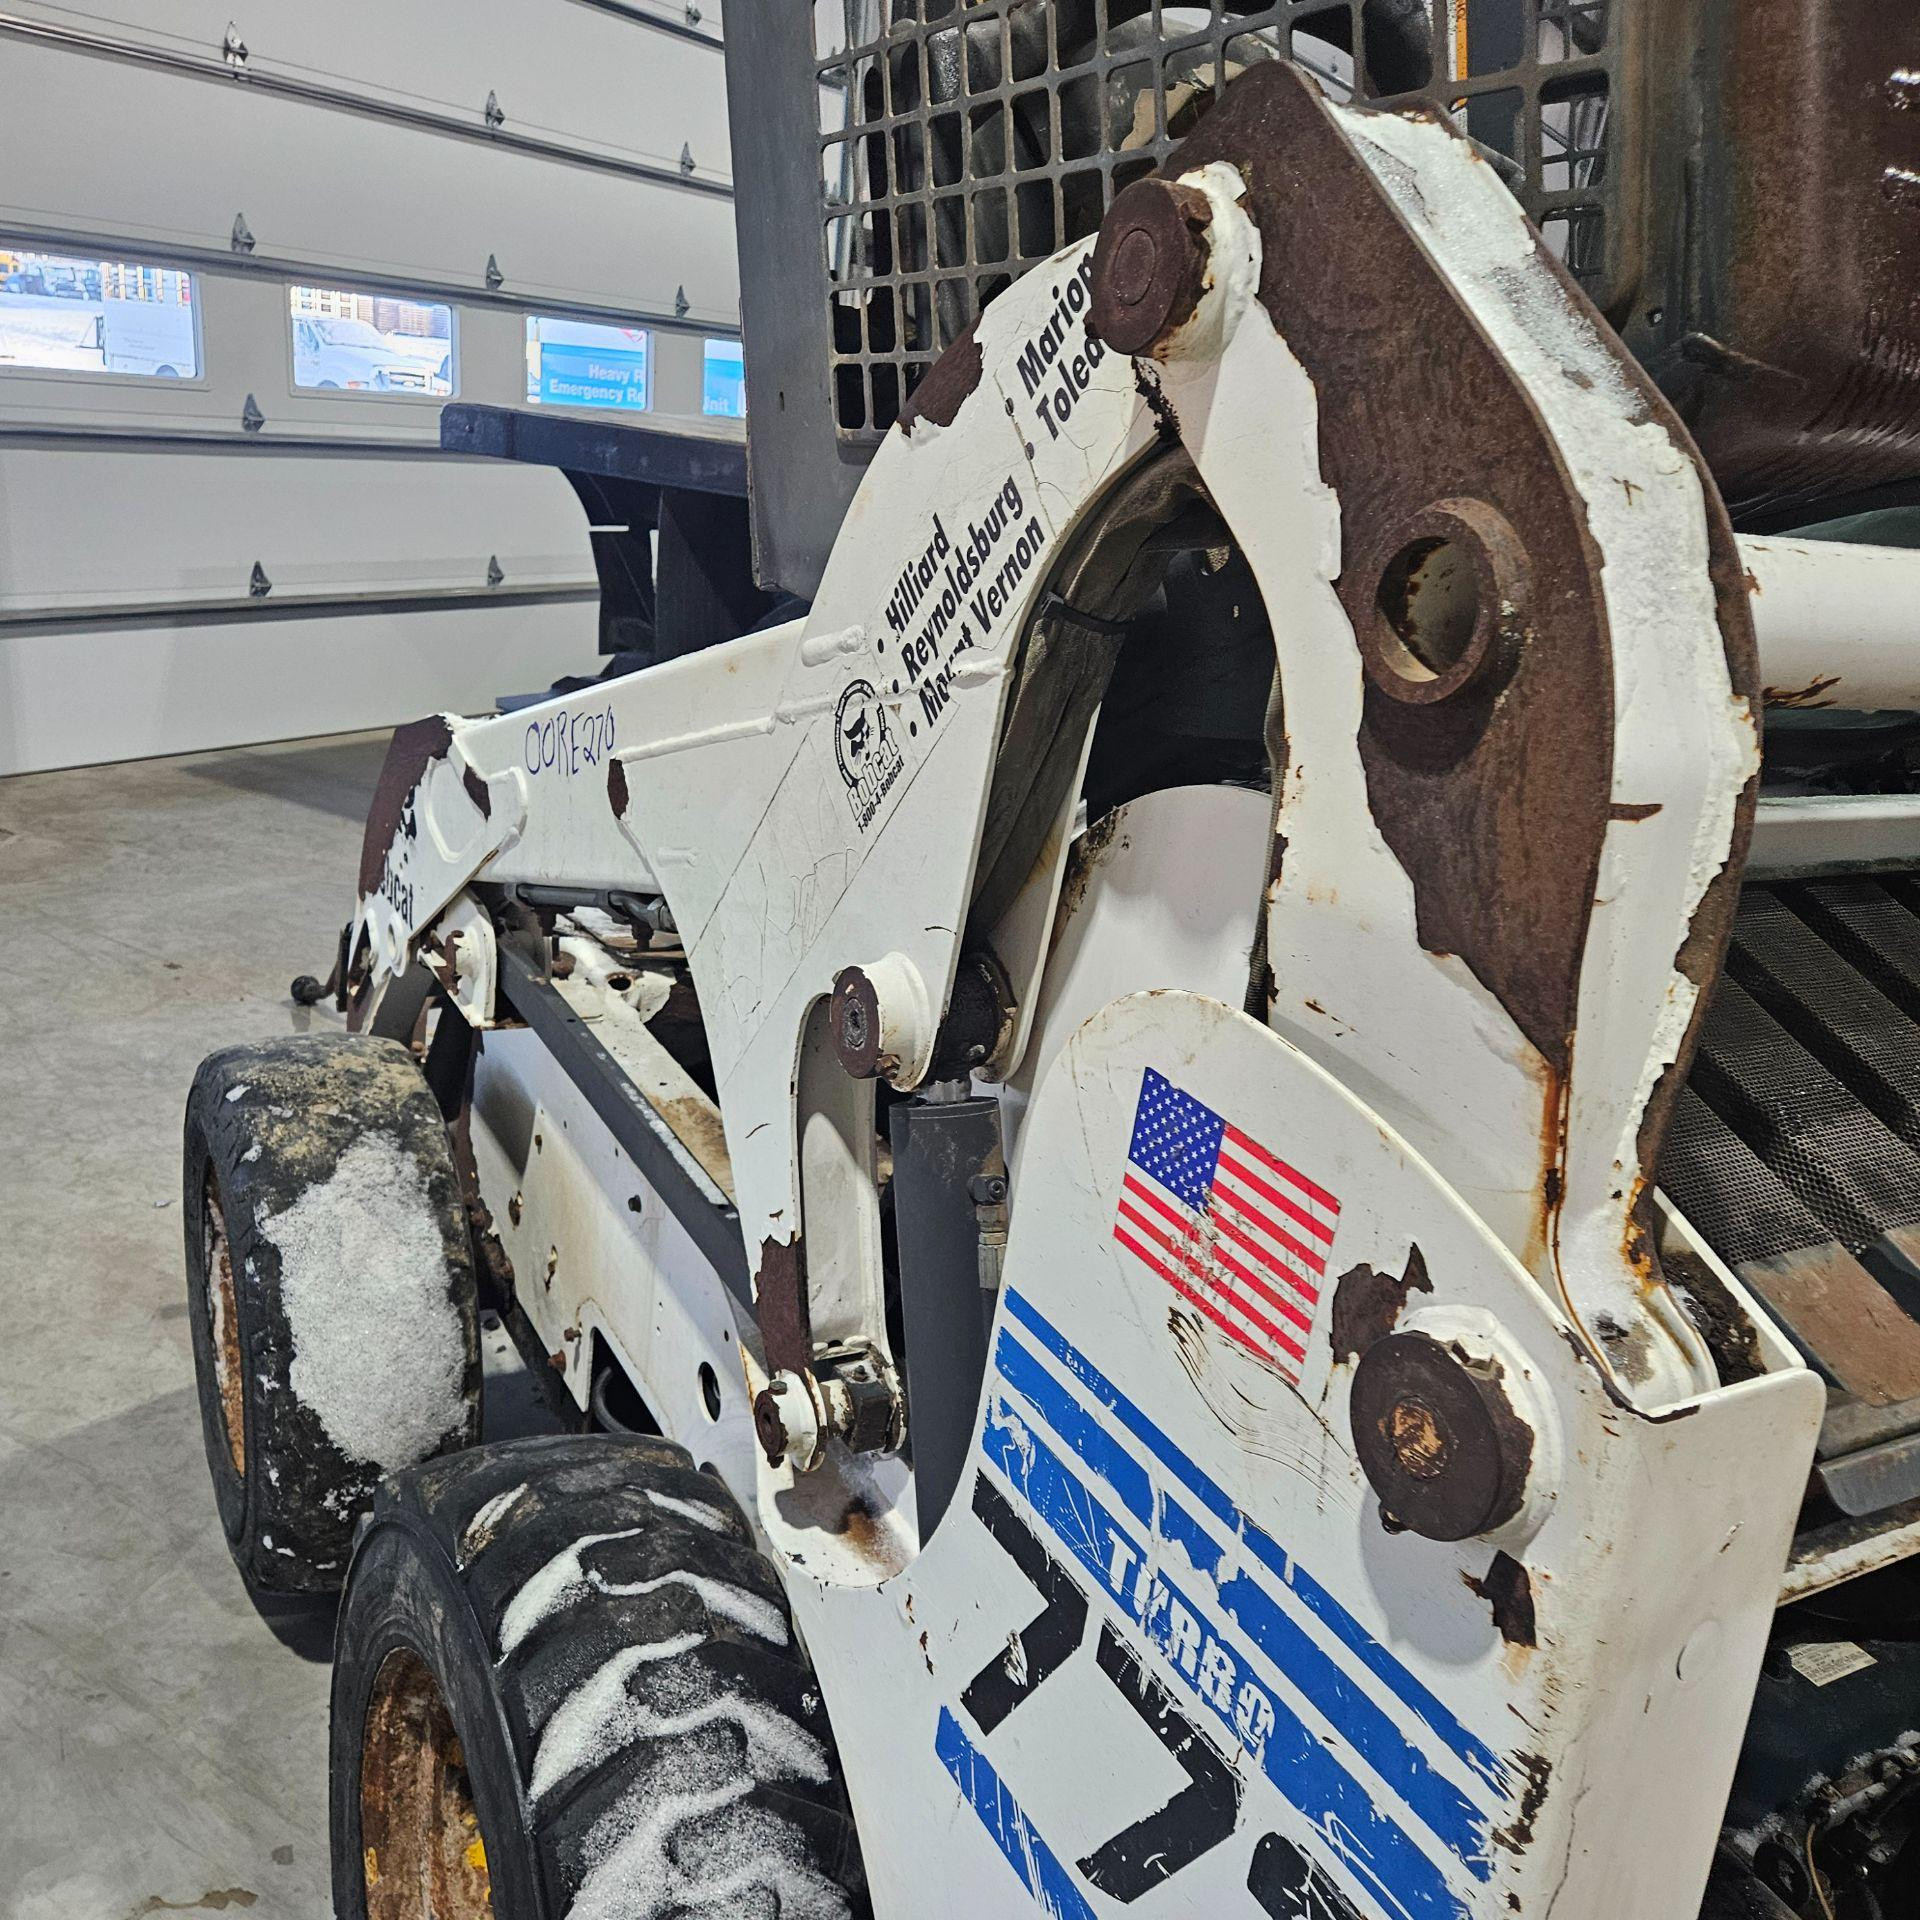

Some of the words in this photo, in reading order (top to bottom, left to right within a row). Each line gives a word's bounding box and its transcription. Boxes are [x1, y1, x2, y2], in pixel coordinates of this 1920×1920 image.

[588, 364, 631, 385] Heavy
[1016, 252, 1096, 400] Marion
[550, 378, 624, 403] Emergency
[885, 512, 951, 642] Hilliard
[900, 474, 1024, 686] Reynoldsburg
[969, 515, 1046, 635] Vernon
[846, 726, 900, 822] Bobcat
